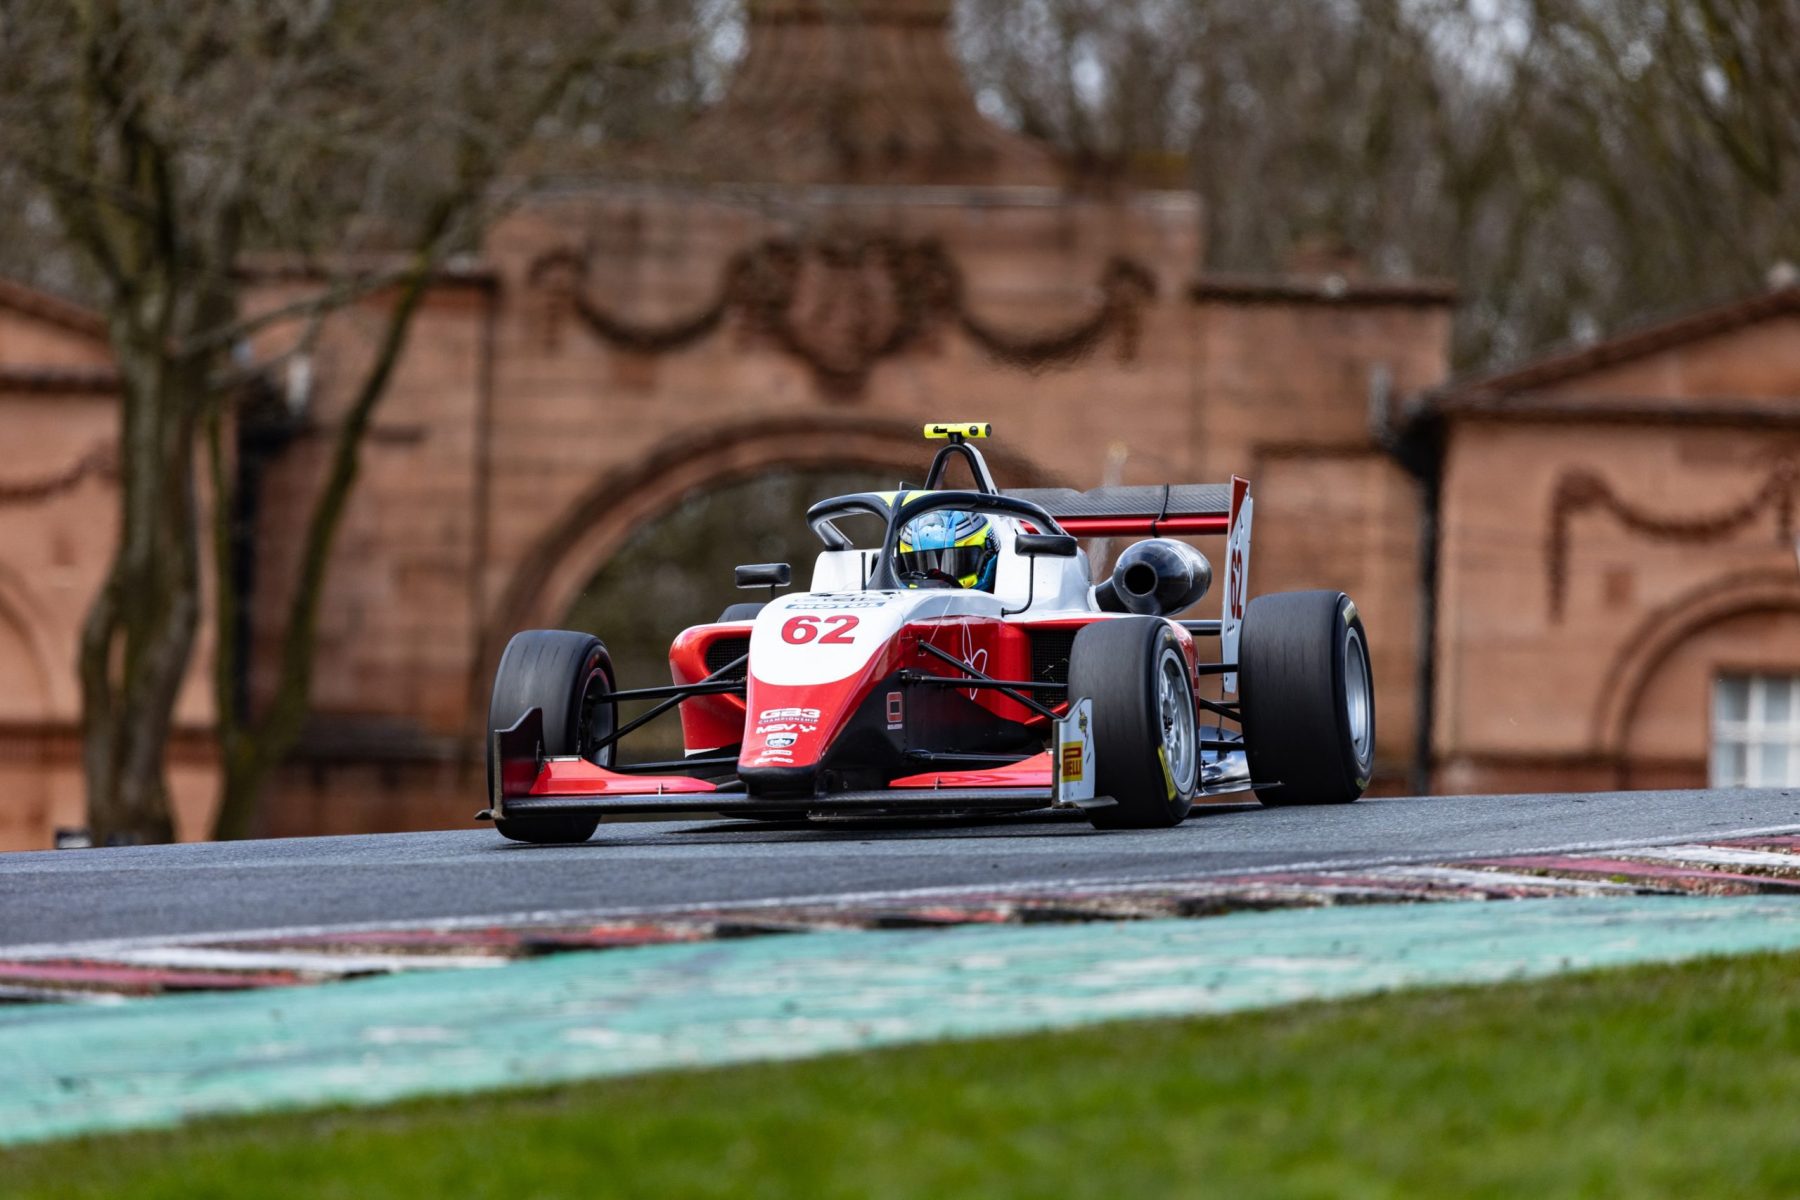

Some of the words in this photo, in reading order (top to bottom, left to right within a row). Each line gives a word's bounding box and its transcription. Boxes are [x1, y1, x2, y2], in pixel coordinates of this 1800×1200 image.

[1230, 547, 1243, 620] 62
[781, 614, 860, 645] 62
[760, 707, 821, 720] GB3
[758, 717, 819, 725] CHAMPIONSHIP
[756, 723, 797, 734] MSV
